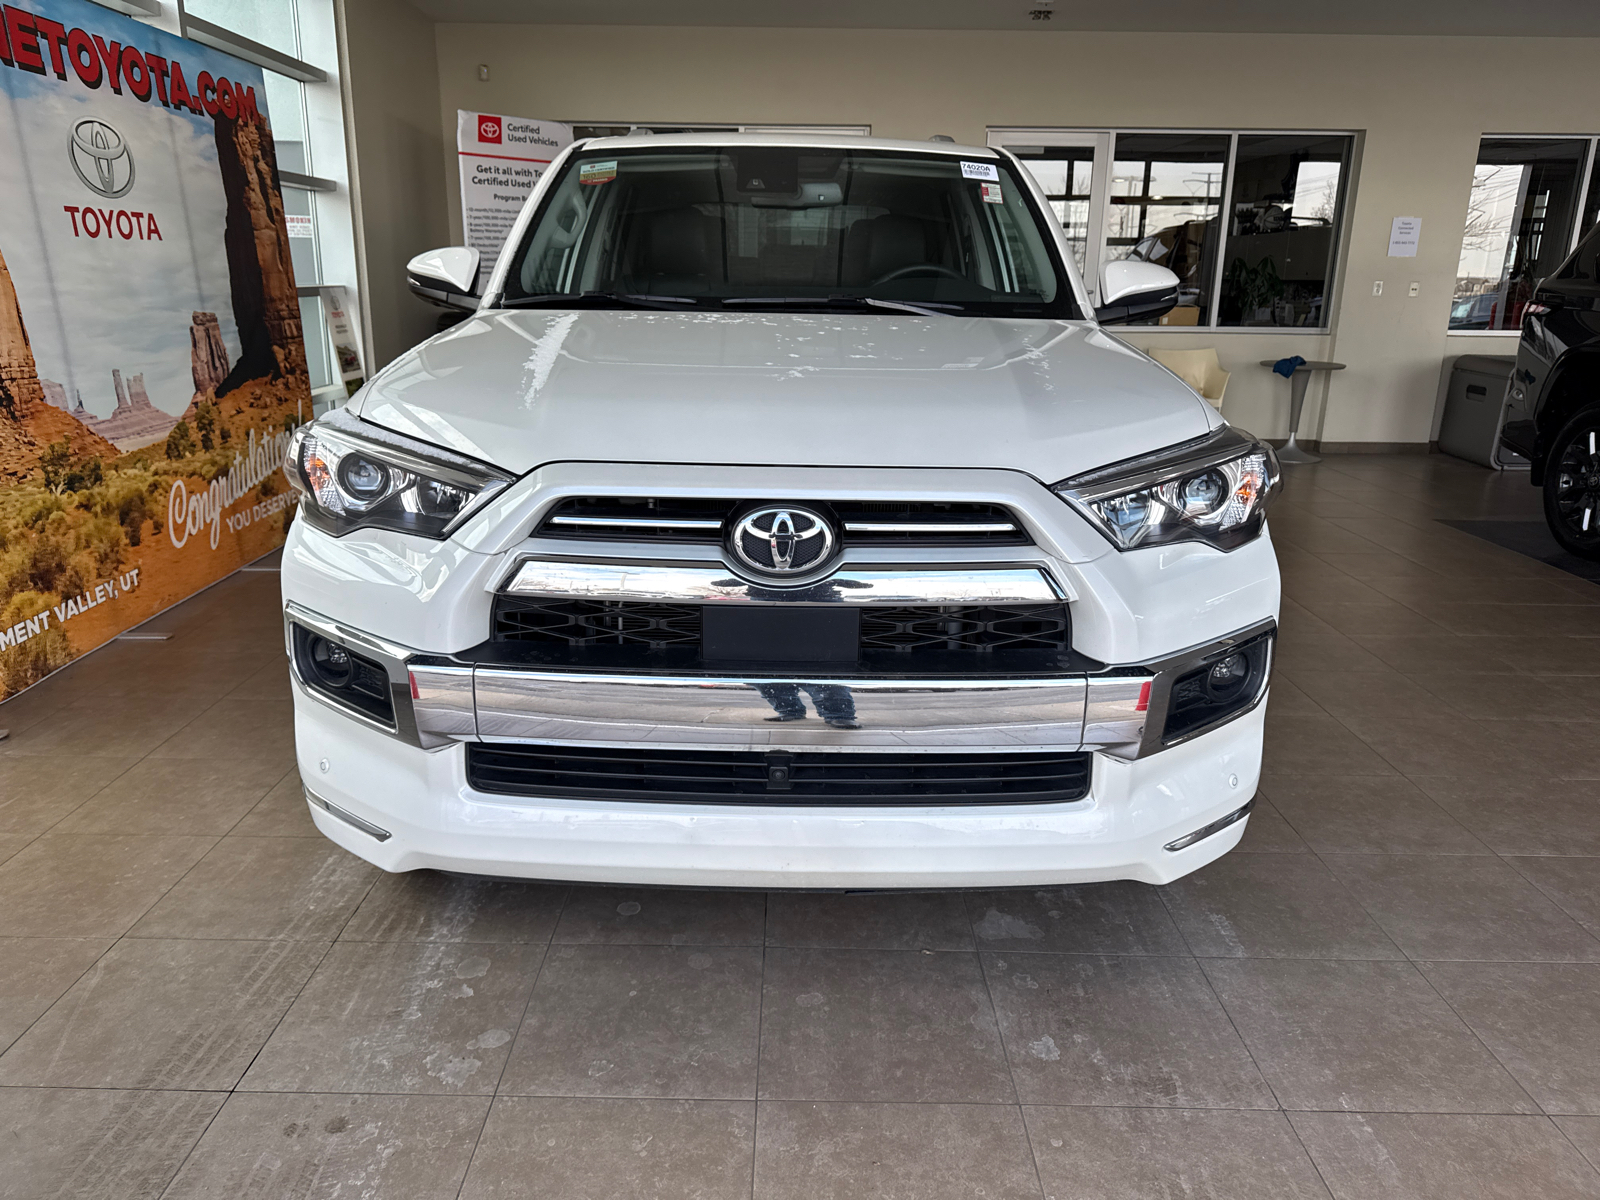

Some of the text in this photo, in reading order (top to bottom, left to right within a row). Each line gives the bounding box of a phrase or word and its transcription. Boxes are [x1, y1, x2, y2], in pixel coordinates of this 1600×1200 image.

[0, 3, 260, 123] ETOYOTA.COM
[507, 123, 540, 135] Certified
[507, 134, 558, 147] Used Vehicles
[476, 164, 492, 174] Get
[494, 166, 500, 174] it
[502, 167, 513, 176] all
[514, 168, 532, 177] with
[472, 176, 509, 187] Certified
[511, 180, 531, 188] Used
[493, 193, 520, 203] Program
[64, 205, 163, 242] TOYOTA
[225, 489, 299, 533] YOU DESERVE
[0, 569, 139, 651] MENT VALLEY, UT
